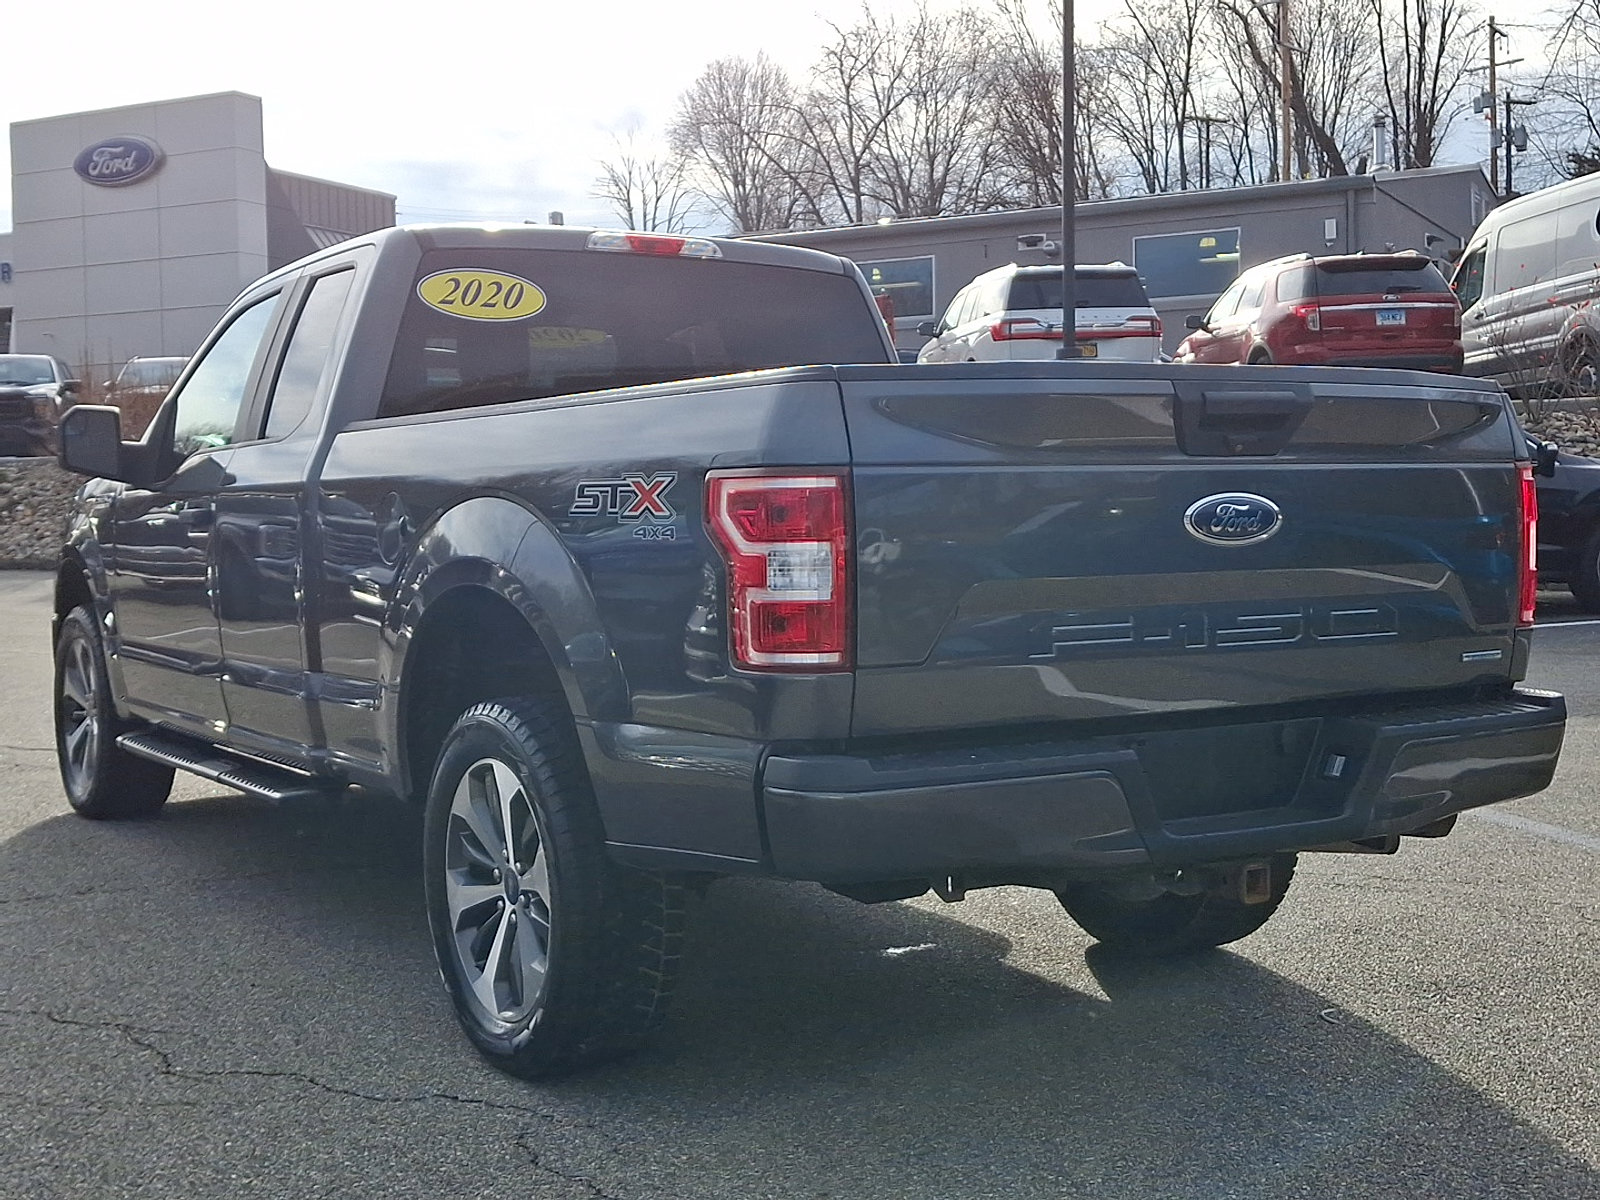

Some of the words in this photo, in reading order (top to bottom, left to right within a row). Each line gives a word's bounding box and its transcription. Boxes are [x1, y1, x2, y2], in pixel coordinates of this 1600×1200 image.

[88, 146, 136, 176] Ford
[437, 277, 525, 310] 2020
[568, 471, 678, 524] STX
[1210, 503, 1262, 532] Ford
[1029, 602, 1399, 658] F-150
